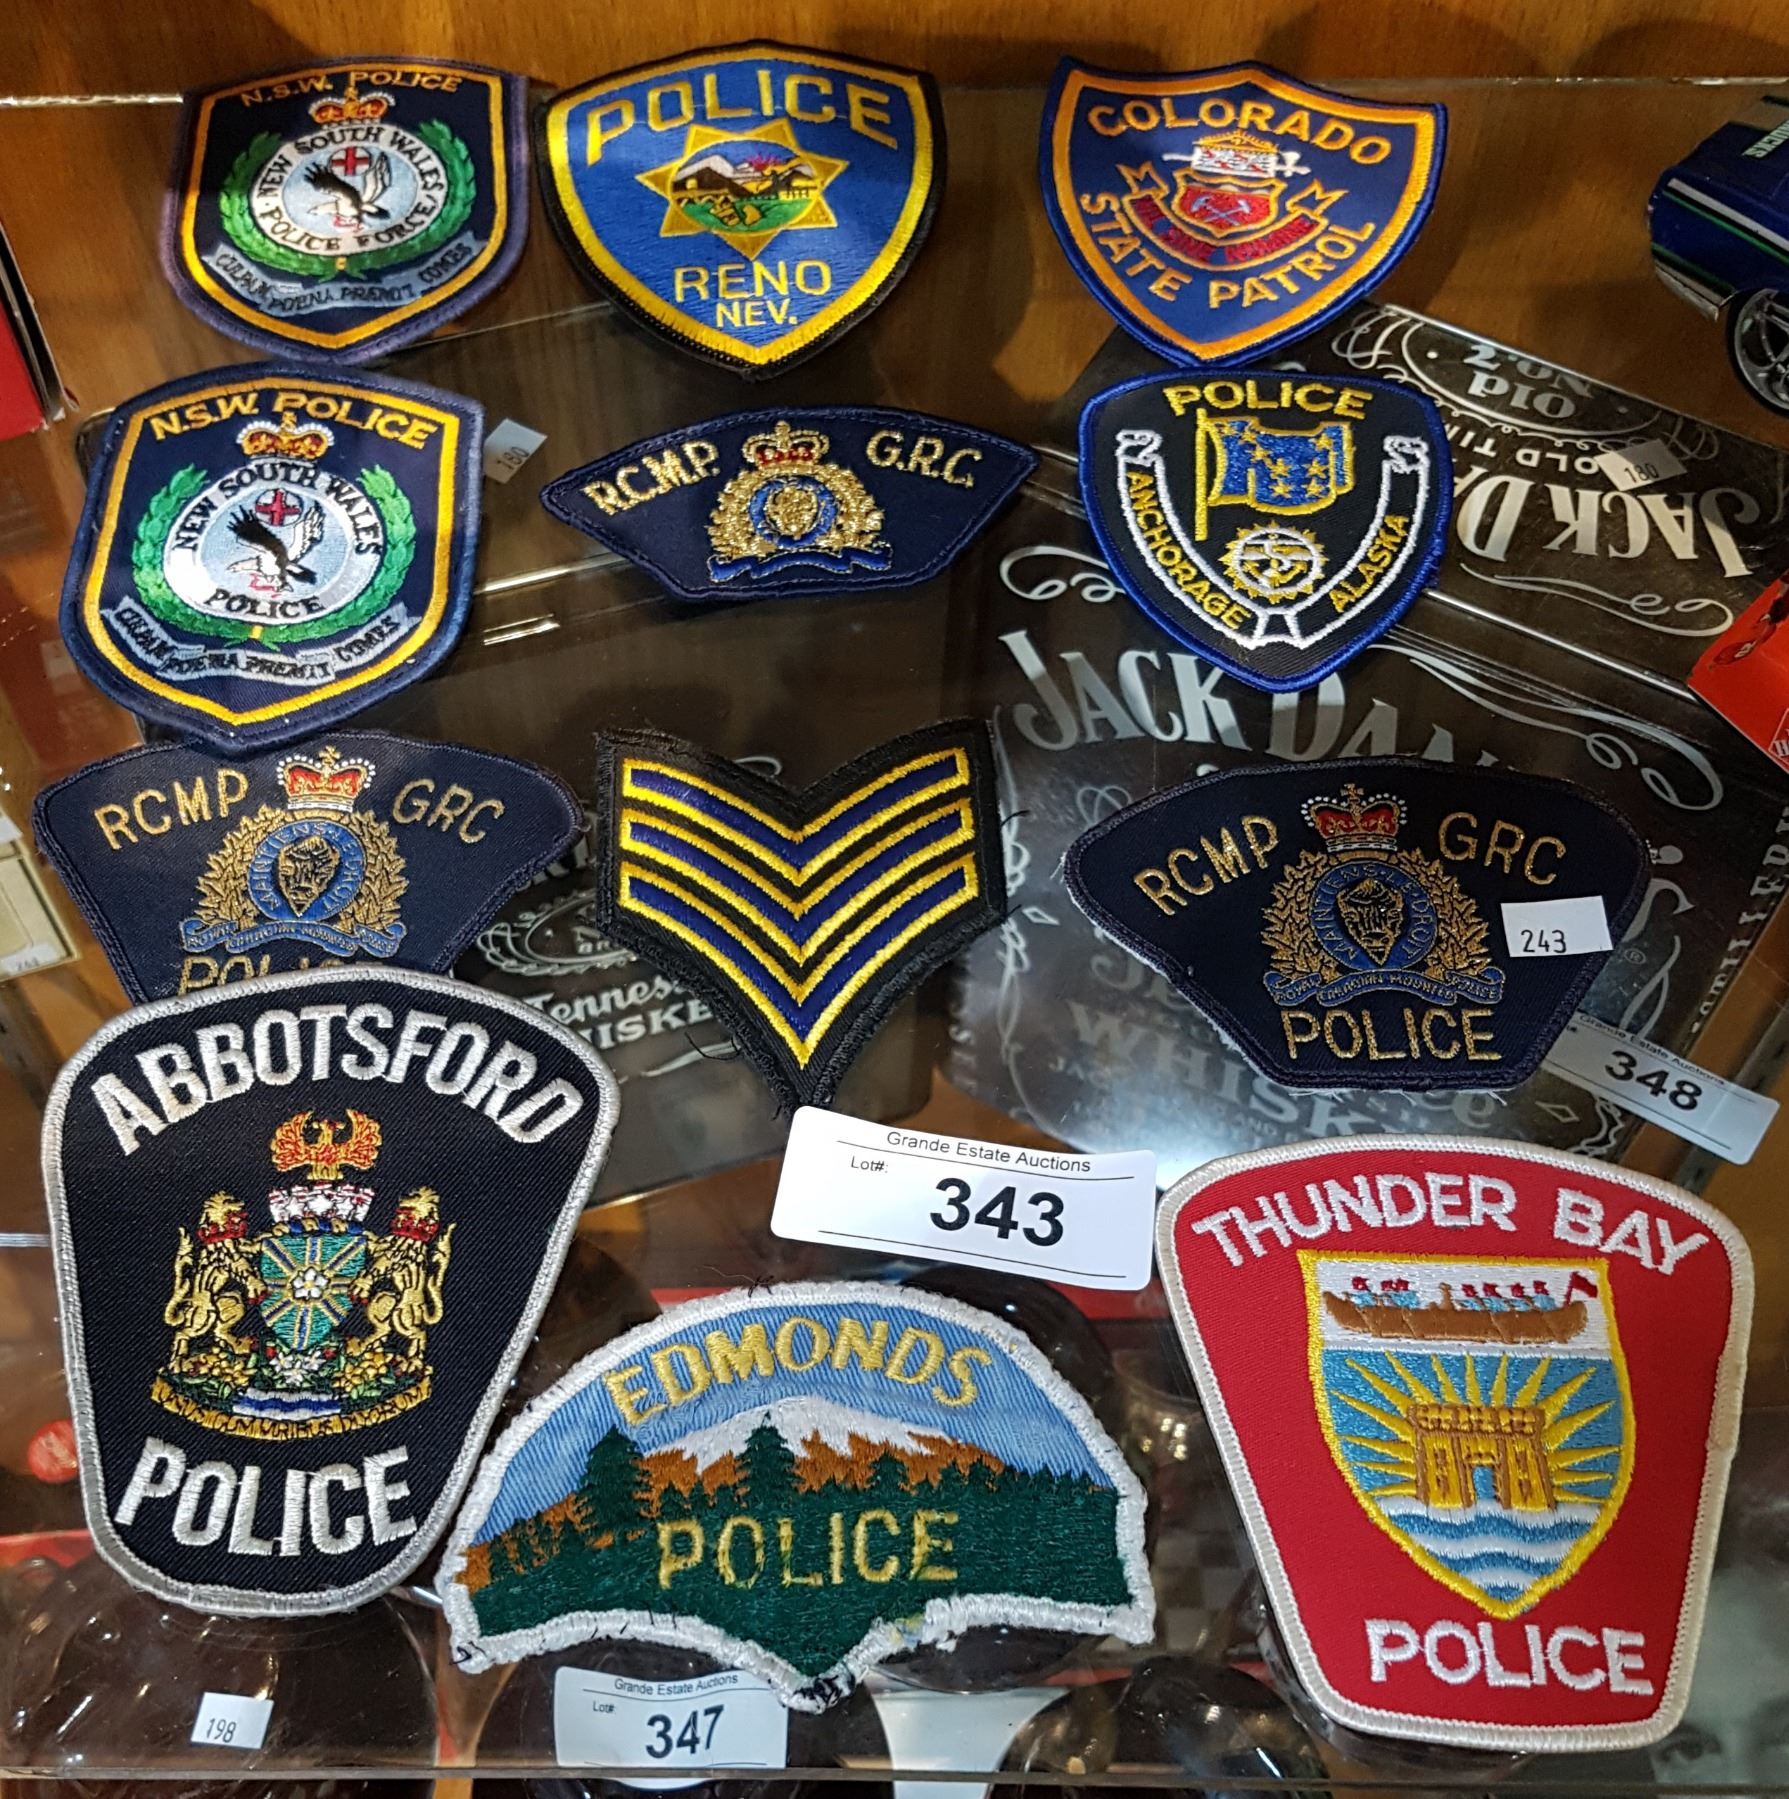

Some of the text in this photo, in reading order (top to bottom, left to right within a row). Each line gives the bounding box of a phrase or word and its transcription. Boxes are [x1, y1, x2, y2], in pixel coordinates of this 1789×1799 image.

[350, 70, 463, 93] POLICE
[587, 70, 898, 166] POLICE
[1088, 97, 1392, 165] COLORADO
[257, 125, 446, 199] NEW SOUTH WALES
[260, 201, 437, 250] POLICE FORCE
[1080, 192, 1192, 302] STATE
[1208, 221, 1376, 308] PATROL
[674, 260, 832, 303] RENO
[716, 299, 798, 328] NEV.
[272, 391, 439, 450] POLICE
[1163, 380, 1373, 420] POLICE
[1468, 370, 1576, 419] Old
[1515, 448, 1600, 475] OLD
[173, 461, 384, 556] NEW SOUTH WALES
[1543, 482, 1761, 579] JACK
[1126, 470, 1251, 630] ANCHORAGE
[1328, 514, 1409, 613] ALASKA
[203, 588, 325, 619] POLICE
[999, 629, 1252, 751] JACK
[93, 767, 250, 851] RCMP
[393, 778, 505, 845] GRC
[1133, 815, 1279, 916] RCMP
[1438, 812, 1567, 886] GRC
[1520, 929, 1567, 955] 243
[1281, 1006, 1502, 1061] POLICE
[1579, 1014, 1725, 1086] Grande Estate Auctions
[91, 1003, 584, 1156] ABBOTSFORD
[1604, 1050, 1703, 1111] 348
[850, 1155, 889, 1174] Lot#:
[886, 1130, 1091, 1173] Grande Estate Auctions
[929, 1176, 1065, 1247] 343
[1192, 1171, 1709, 1276] THUNDER BAY
[604, 1316, 993, 1426] EDMONDS
[115, 1436, 417, 1557] POLICE
[657, 1508, 960, 1590] POLICE
[614, 1673, 739, 1696] Grande Estate Auctions
[1364, 1619, 1654, 1696] POLICE
[205, 1716, 238, 1743] 198
[645, 1703, 725, 1759] 347
